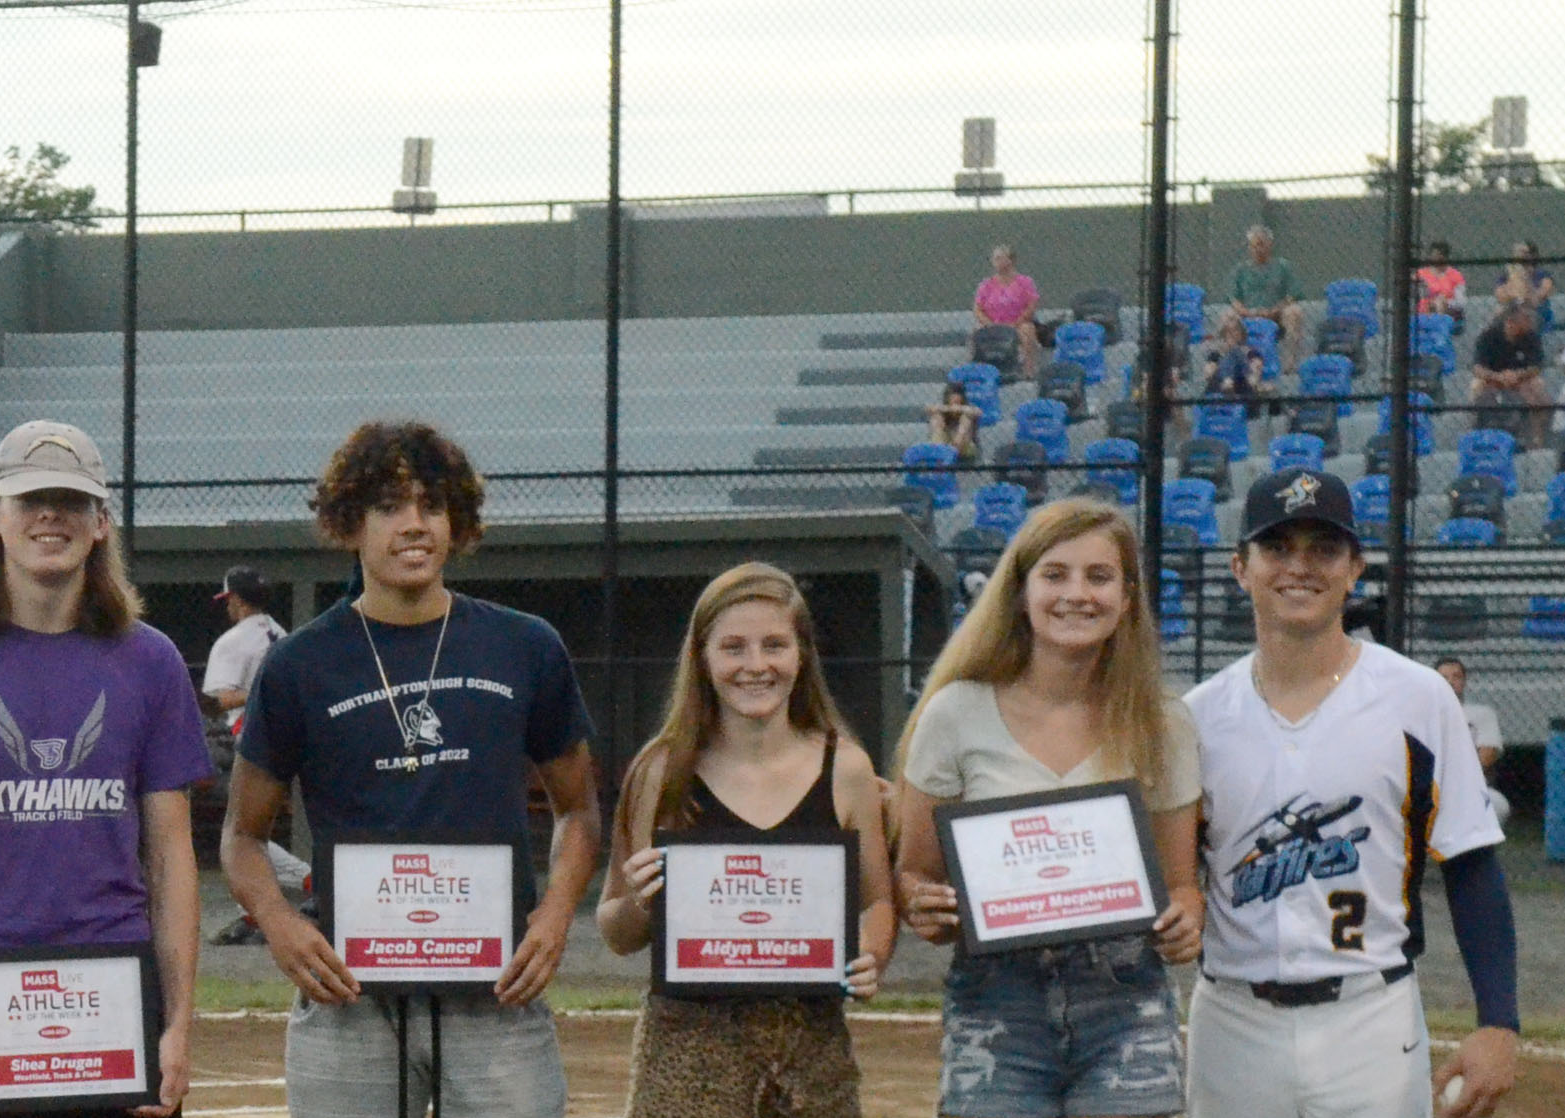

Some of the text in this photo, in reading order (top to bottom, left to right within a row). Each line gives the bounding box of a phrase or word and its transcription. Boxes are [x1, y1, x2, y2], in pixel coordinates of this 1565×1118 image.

[327, 677, 514, 718] NORTHAMPTON HIGH SCHOOL
[421, 753, 436, 766] OF
[438, 748, 469, 761] 2022
[12, 812, 46, 823] TRACK
[57, 810, 83, 821] FIELD
[1002, 830, 1096, 859] ATHLETE
[395, 858, 427, 869] MASS
[378, 877, 470, 894] ATHLETE
[709, 878, 802, 895] ATHLETE
[1328, 890, 1367, 951] 2
[365, 940, 483, 955] Jacob Cancel
[757, 940, 811, 956] Welsh
[24, 973, 83, 985] MASS LIVE
[7, 990, 100, 1012] ATHLETE
[10, 1056, 103, 1072] Shea Drugan
